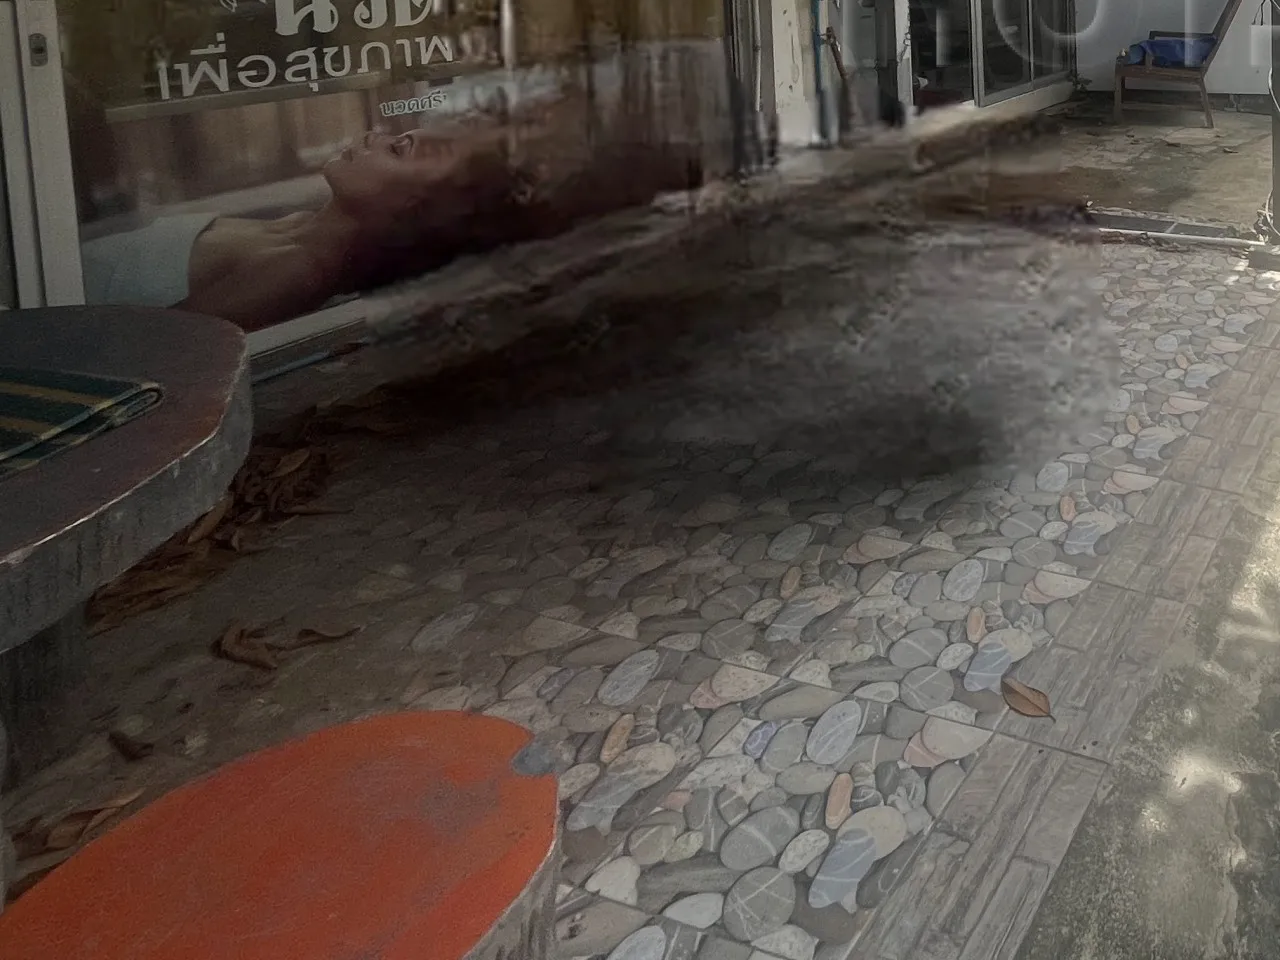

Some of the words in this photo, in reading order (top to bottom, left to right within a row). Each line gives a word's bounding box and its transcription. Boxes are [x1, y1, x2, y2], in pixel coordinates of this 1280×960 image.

[157, 32, 455, 101] เพื่อสุขภาพ
